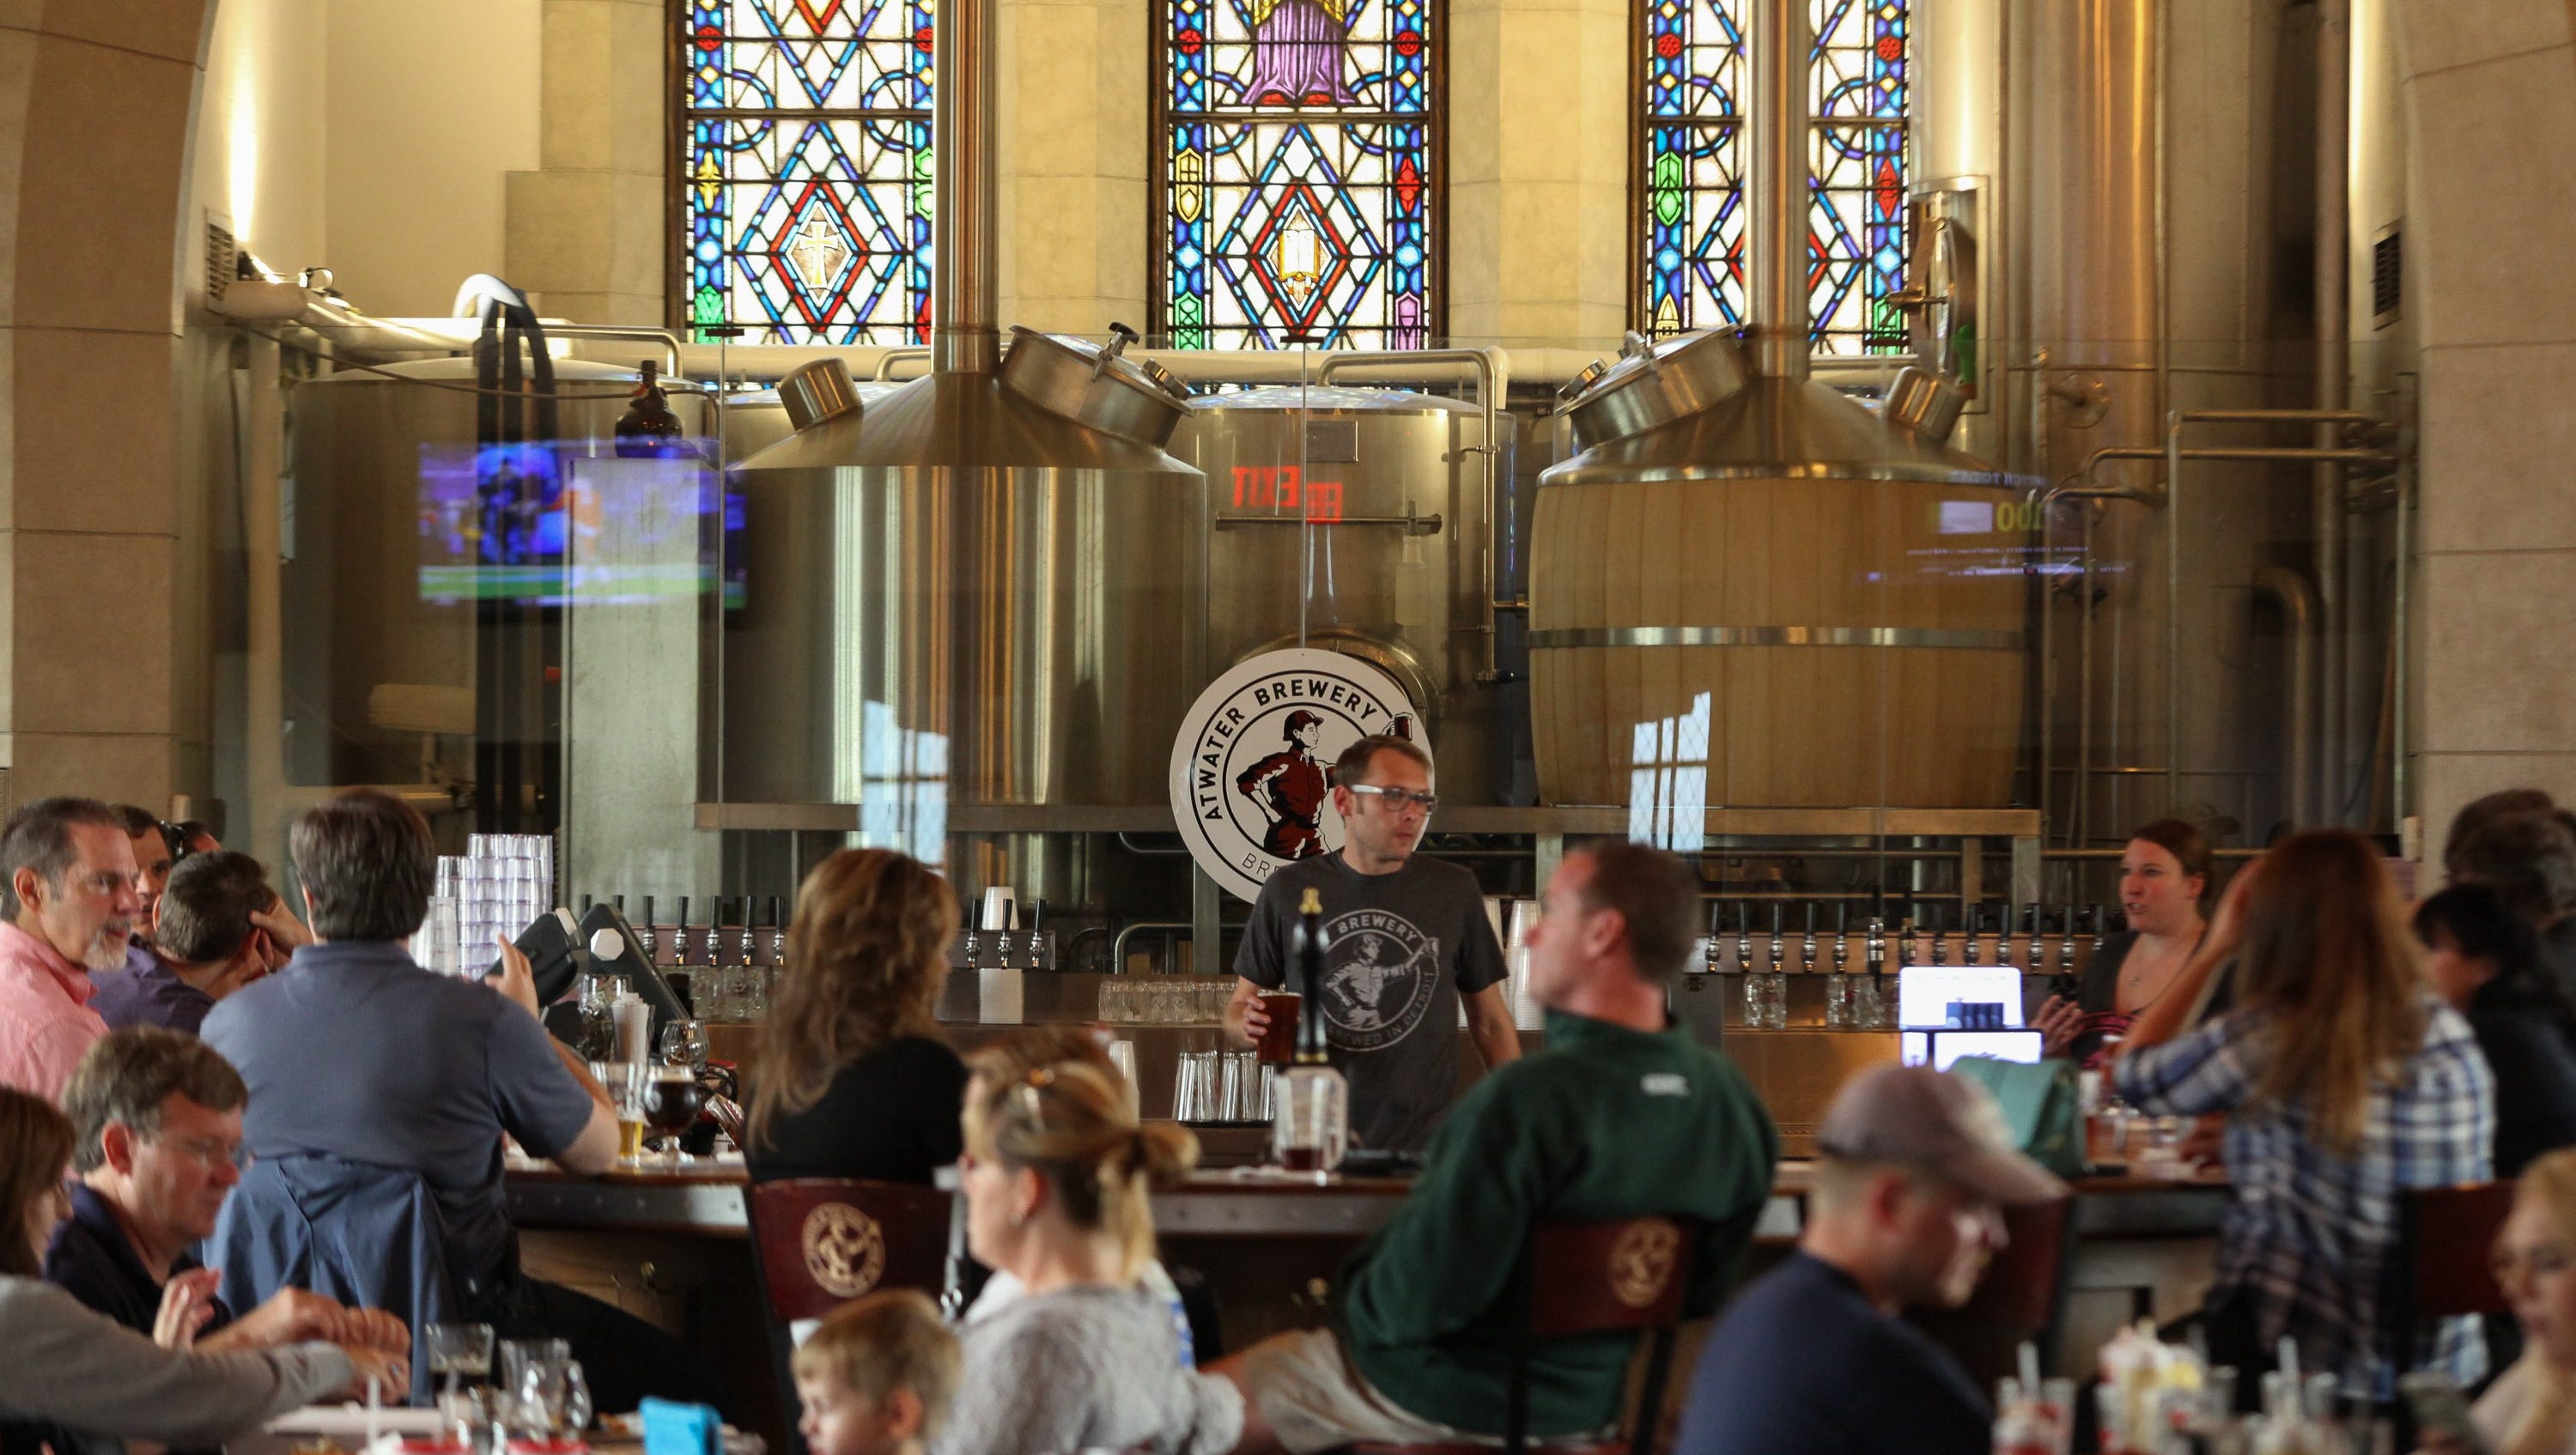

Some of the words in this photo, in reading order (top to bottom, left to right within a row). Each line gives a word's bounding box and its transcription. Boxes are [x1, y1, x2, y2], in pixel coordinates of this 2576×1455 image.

[1198, 706, 1246, 821] ATWATER
[1253, 678, 1378, 721] BREWERY
[1336, 914, 1418, 943] BREWERY
[1386, 1023, 1402, 1039] IN
[1402, 971, 1434, 1027] DETROIT
